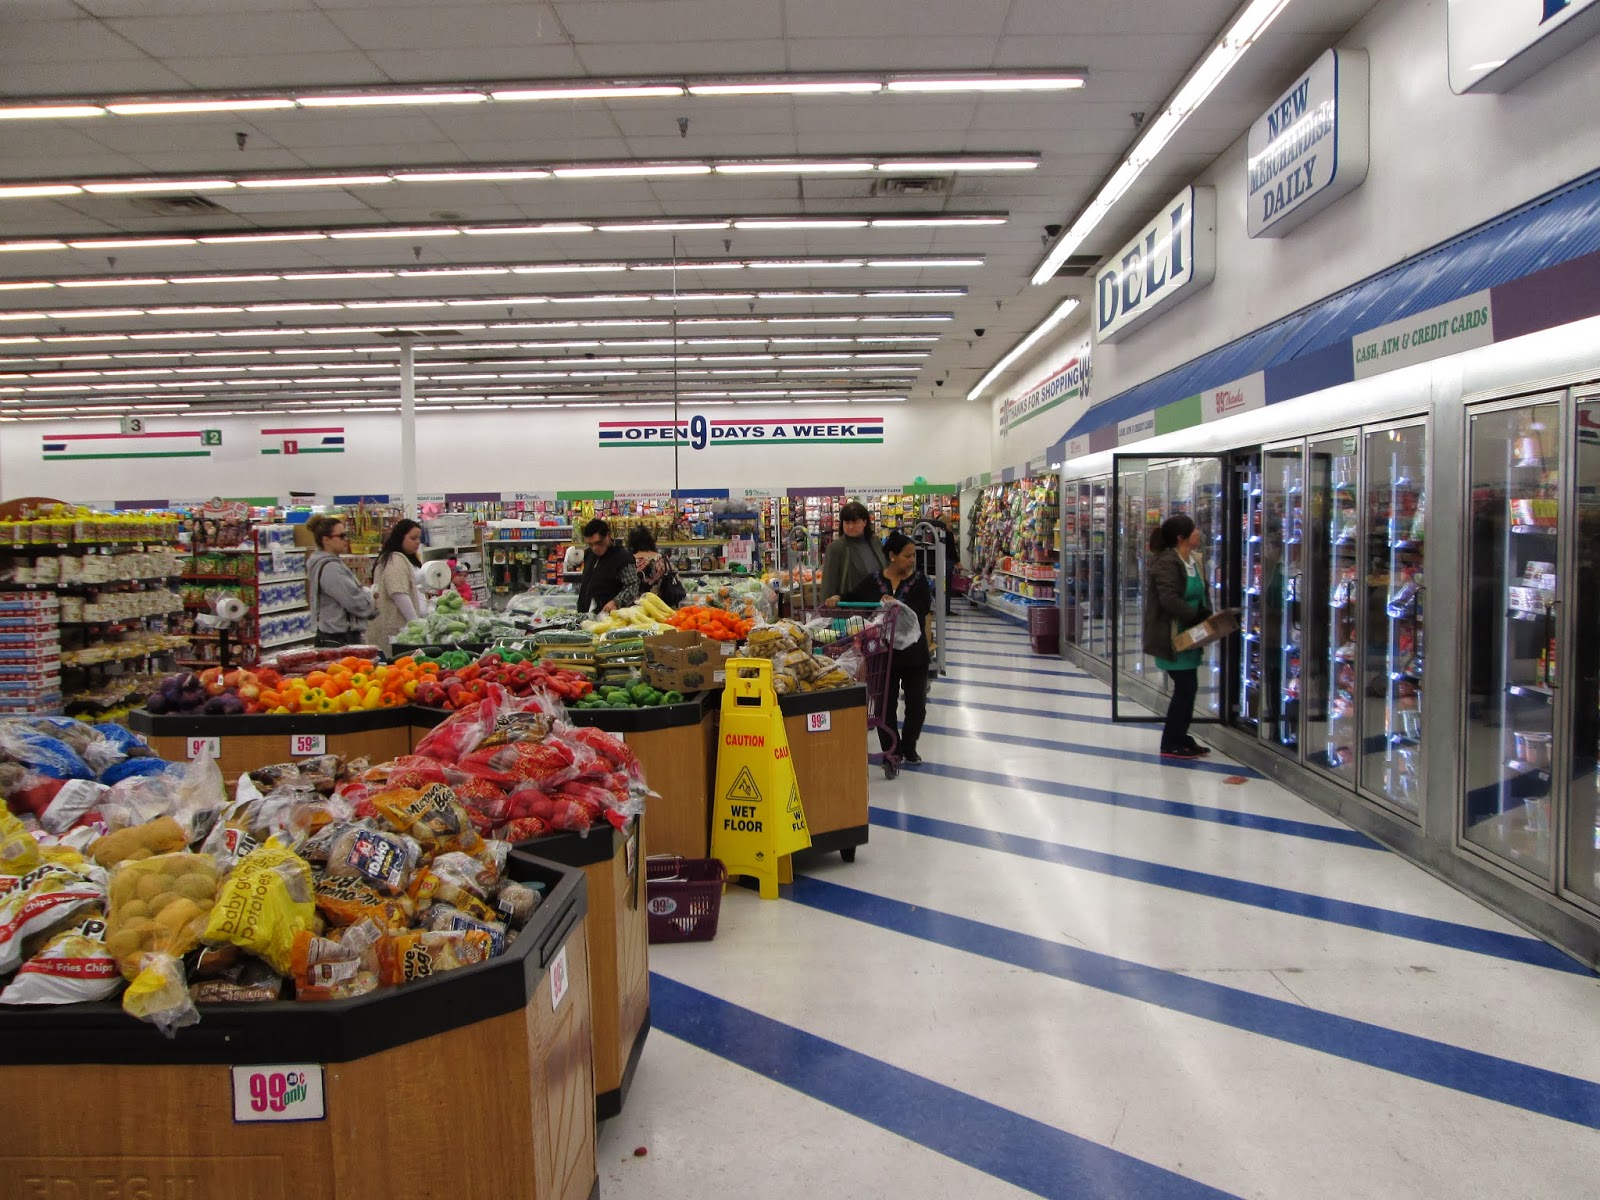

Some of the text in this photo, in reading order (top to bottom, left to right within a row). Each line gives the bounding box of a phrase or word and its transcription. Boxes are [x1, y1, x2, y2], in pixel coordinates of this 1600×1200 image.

[1267, 77, 1310, 144] NEW
[1250, 104, 1333, 196] MERCHANDISE
[1262, 154, 1316, 222] DAILY
[1099, 202, 1184, 332] DELI
[1356, 306, 1488, 363] CASH, ATM & CREDIT CARDS
[1028, 391, 1040, 411] FOR
[1041, 367, 1079, 402] SHOPPING
[131, 419, 141, 431] 3
[209, 433, 219, 444] 2
[625, 415, 856, 450] OPEN 9 DAYS A WEEK
[287, 443, 293, 452] 1
[811, 714, 822, 728] 99
[297, 736, 312, 751] 59
[725, 734, 765, 747] CAUTION
[724, 819, 762, 833] FLOOR
[731, 805, 756, 818] WET
[367, 841, 391, 876] IDAHO
[216, 892, 247, 934] baby
[241, 873, 272, 941] potatoes
[653, 899, 666, 913] 99
[56, 963, 81, 972] Fries
[85, 963, 113, 973] Chips
[250, 1073, 287, 1112] 99
[283, 1084, 307, 1106] only
